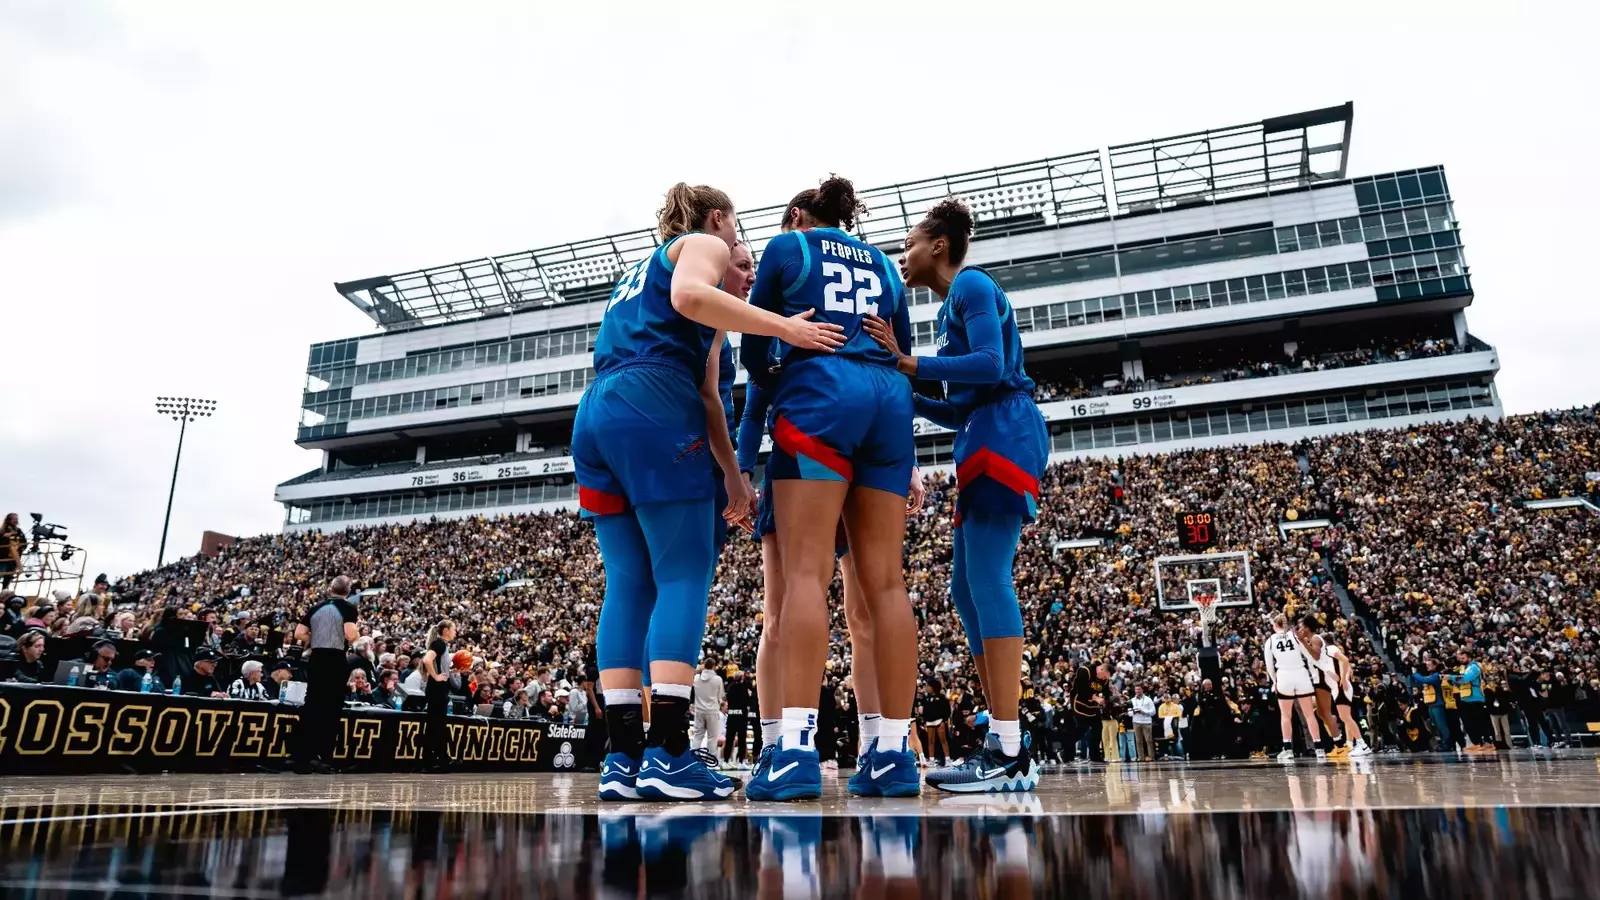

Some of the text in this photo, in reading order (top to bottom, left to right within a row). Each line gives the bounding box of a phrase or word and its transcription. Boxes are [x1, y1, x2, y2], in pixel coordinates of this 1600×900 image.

[821, 239, 873, 265] PEOPLES
[822, 261, 883, 314] 22
[1133, 396, 1151, 409] 99
[1153, 394, 1173, 402] Andre
[1153, 400, 1177, 408] Tippett
[1070, 404, 1087, 416] 16
[1089, 401, 1110, 409] Chuck
[497, 467, 512, 478] 25
[543, 462, 550, 473] 2
[411, 476, 424, 486] 78
[452, 471, 466, 482] 36
[1183, 513, 1211, 525] 10:00
[1187, 524, 1209, 544] 30
[1276, 639, 1295, 653] 44
[394, 720, 541, 763] KNNICK
